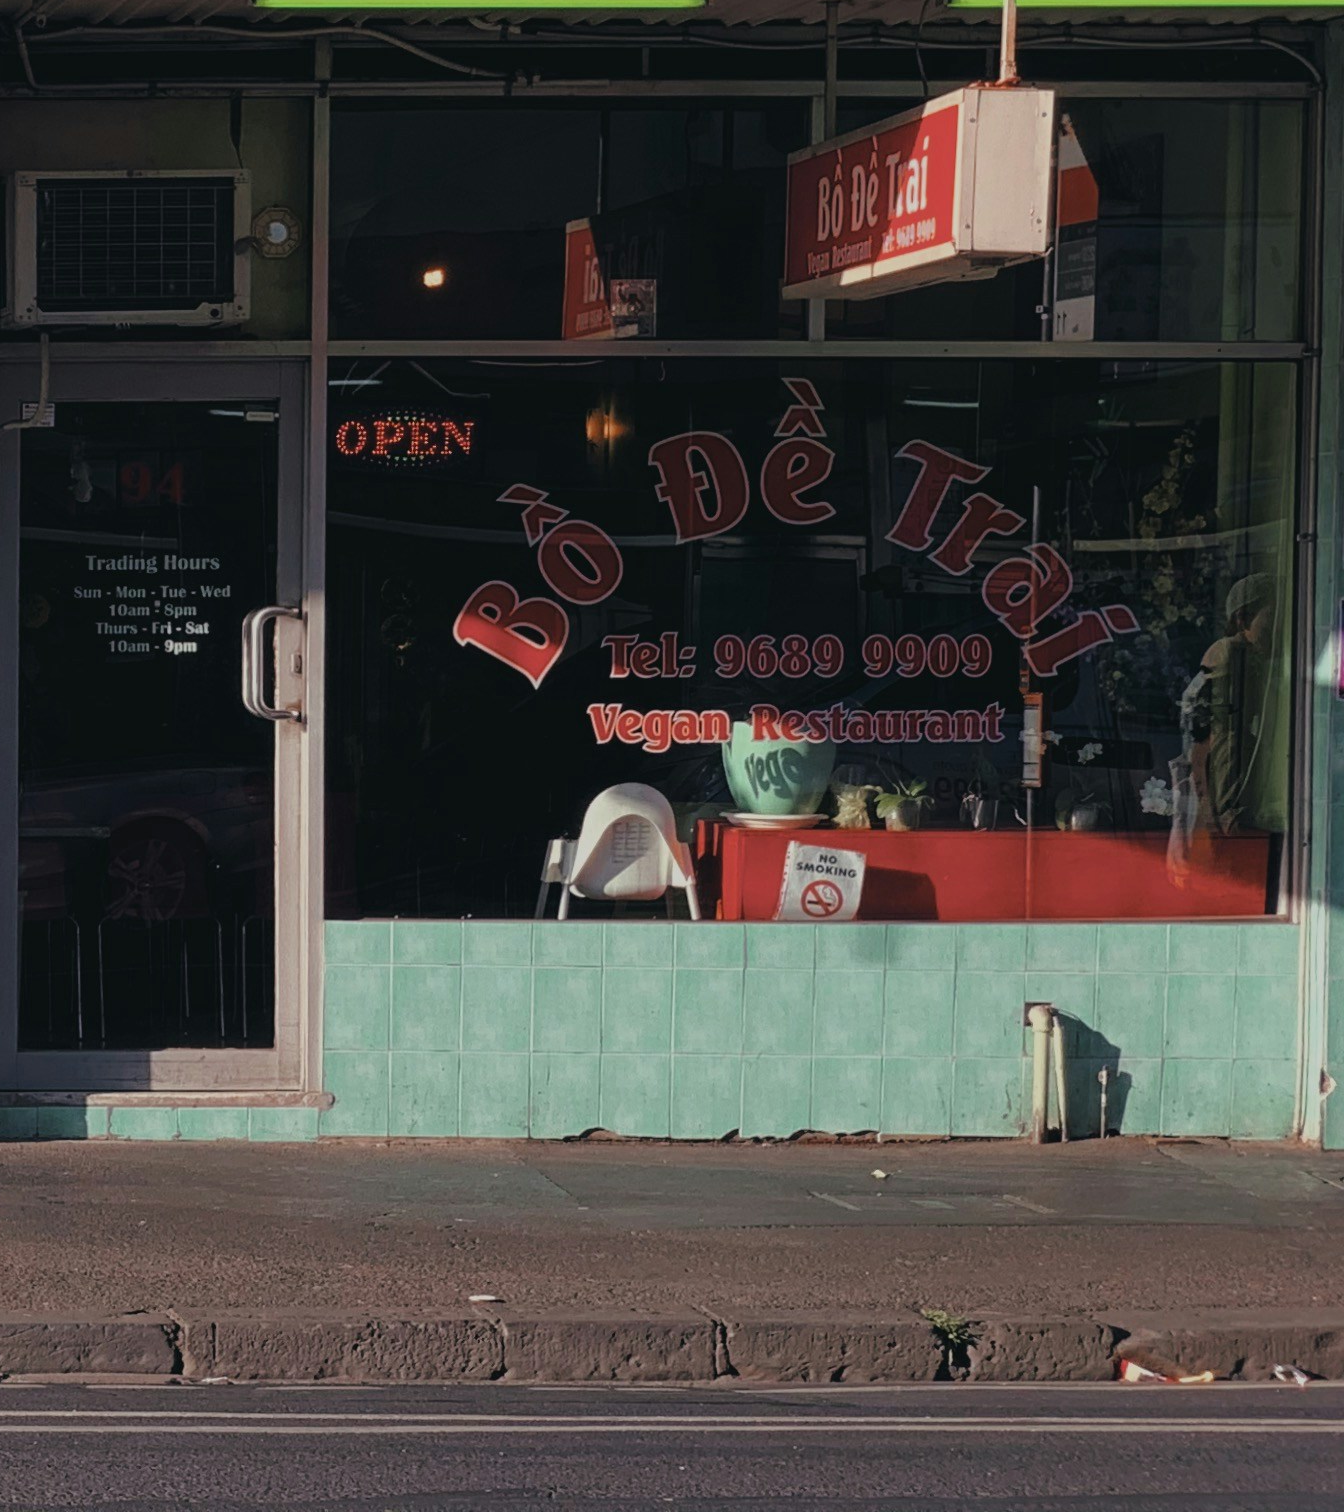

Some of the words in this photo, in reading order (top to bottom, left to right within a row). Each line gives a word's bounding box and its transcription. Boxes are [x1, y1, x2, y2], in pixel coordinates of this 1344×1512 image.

[817, 149, 844, 241] Bồ
[851, 135, 879, 232] Đề
[885, 136, 930, 220] Trai
[832, 236, 872, 269] Restaurant
[335, 420, 475, 456] OPEN
[120, 461, 187, 505] 94
[453, 483, 624, 690] Bồ
[648, 377, 836, 545] Đề
[884, 439, 1141, 677] Trai
[85, 555, 158, 573] Trading
[163, 555, 220, 570] Hours
[74, 586, 102, 598] Sun
[116, 586, 146, 598] Mon
[160, 586, 187, 598] Tue
[200, 585, 231, 598] Wed
[109, 604, 150, 616] 10am
[164, 604, 197, 618] 8pm
[96, 622, 137, 634] Thurs
[152, 622, 172, 634] Fri
[185, 621, 209, 634] Sat
[109, 641, 150, 653] 10am
[164, 640, 197, 655] 9pm
[600, 631, 697, 679] Tel:
[714, 634, 844, 679] 9689
[862, 634, 992, 678] 9909
[587, 703, 732, 753] Vegan
[749, 701, 1006, 744] Restaurant
[796, 862, 857, 879] SMOKING
[819, 854, 837, 864] NO
